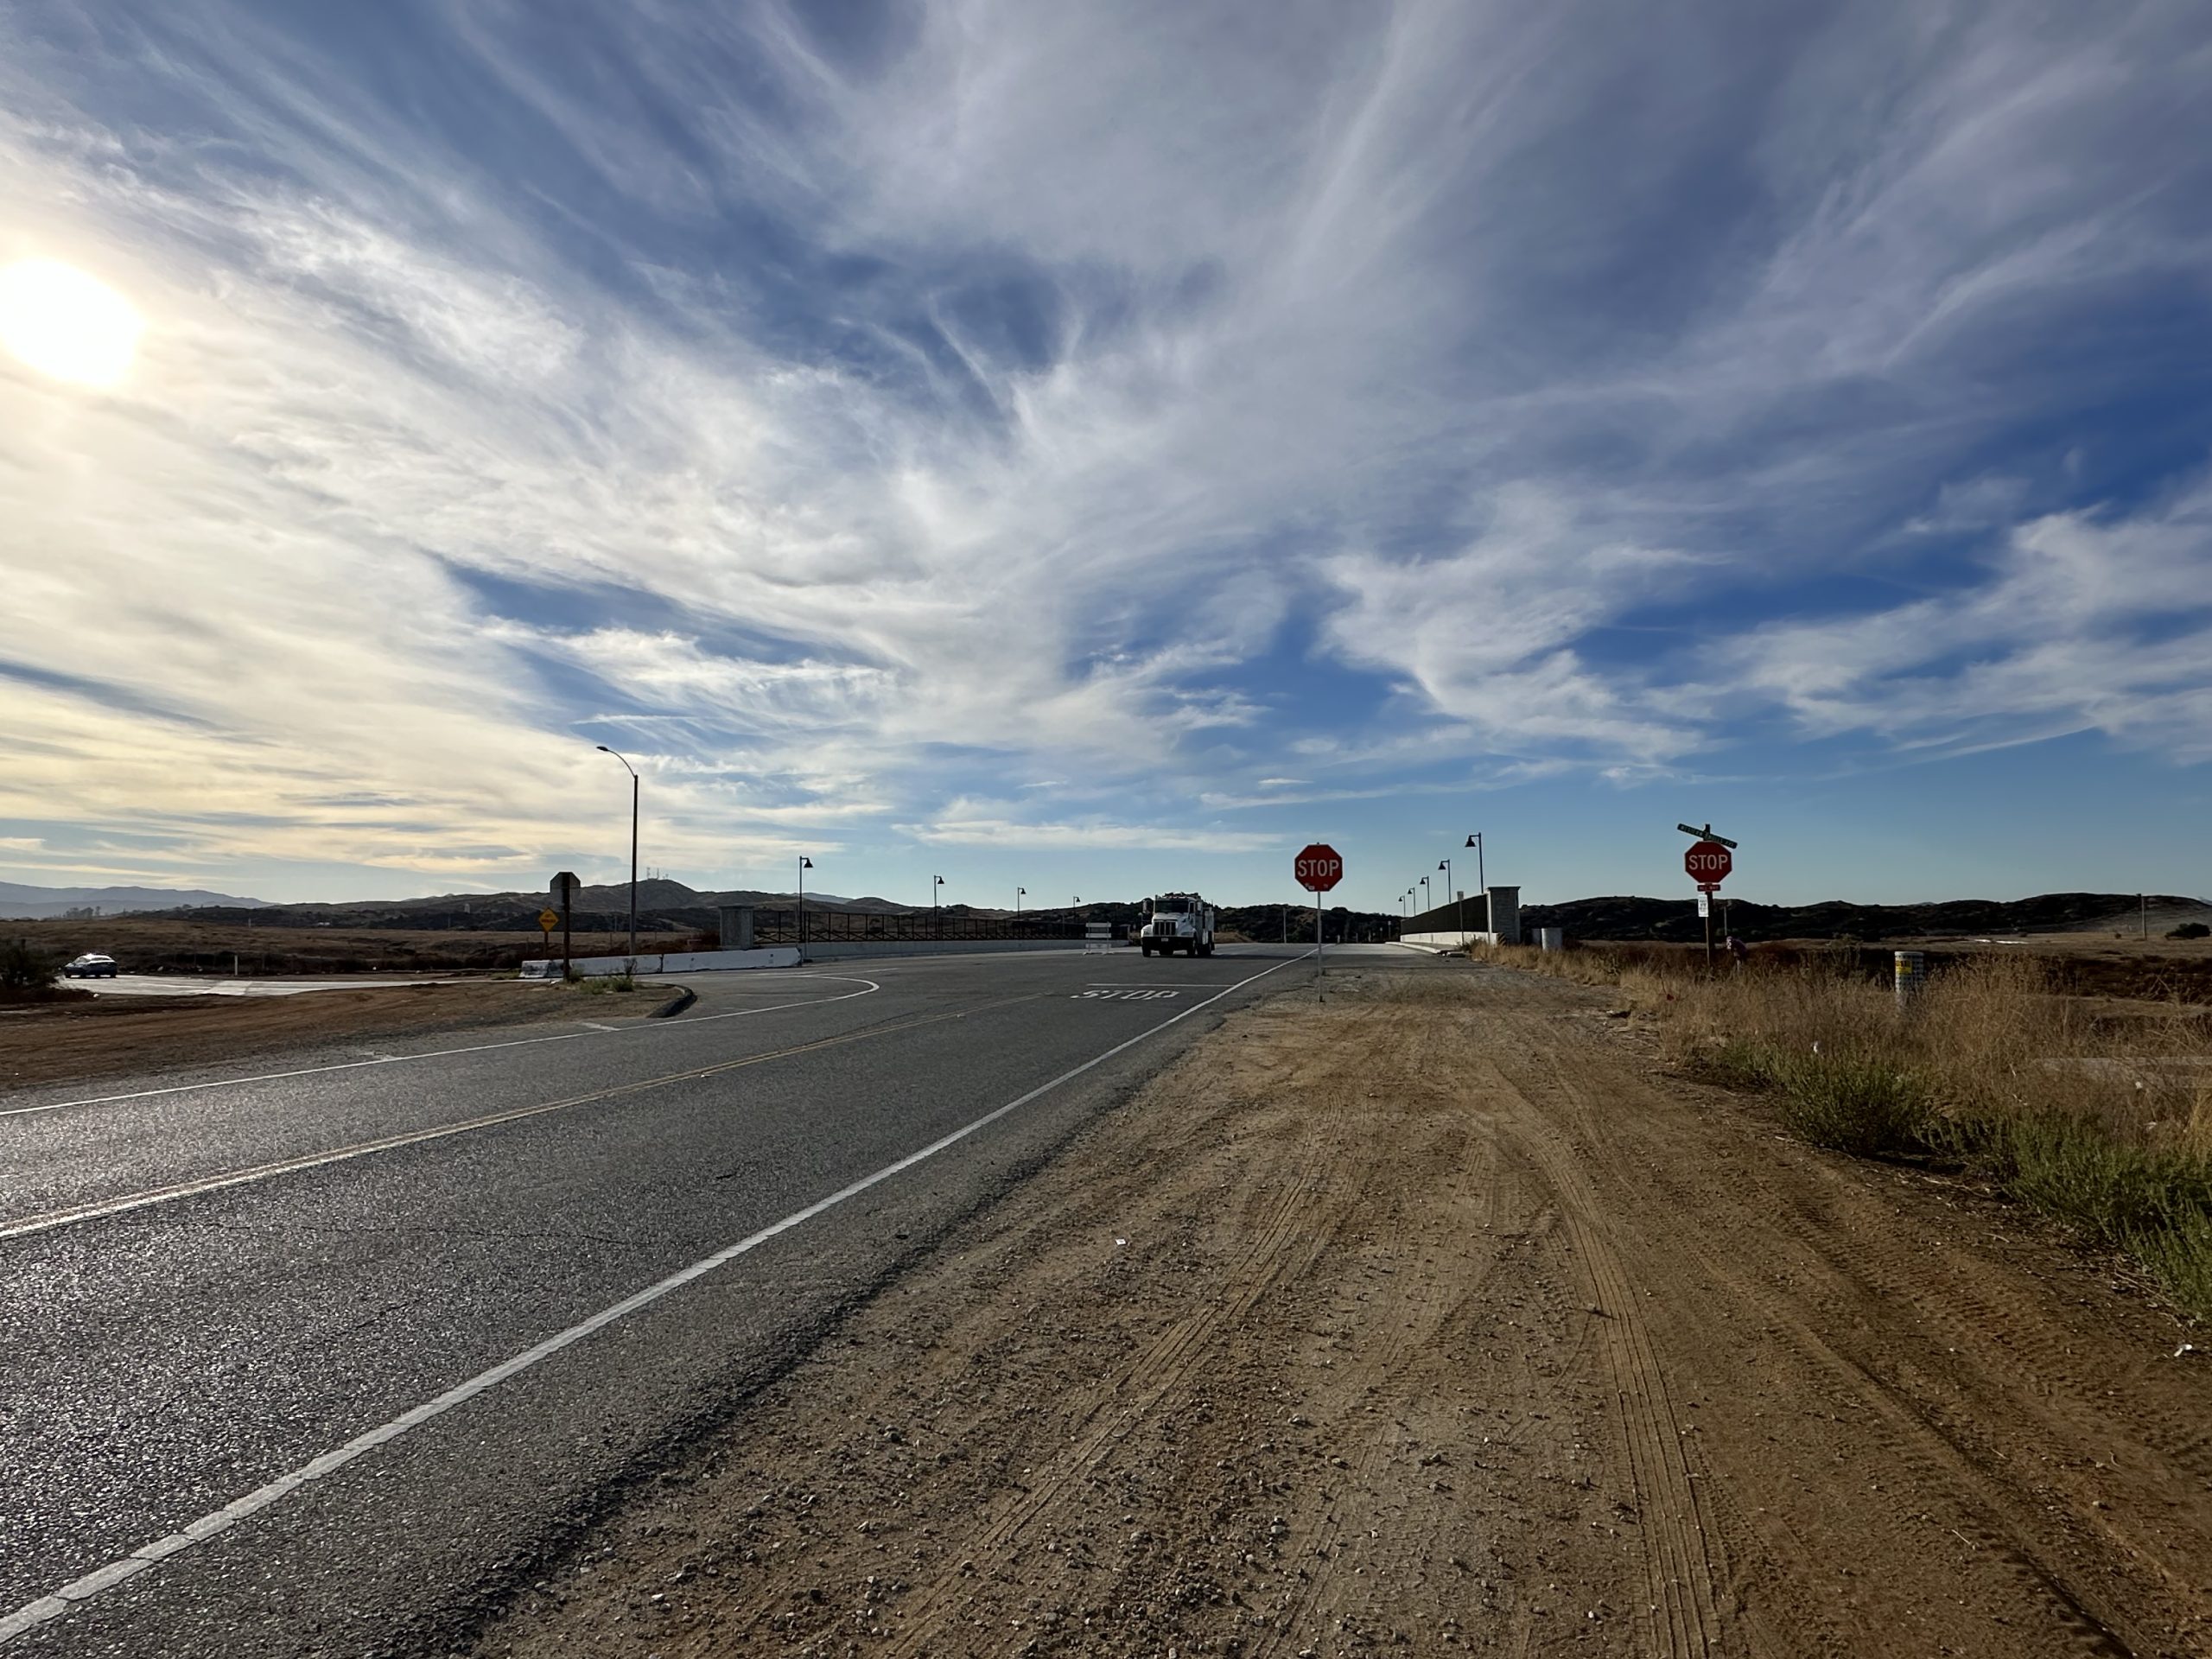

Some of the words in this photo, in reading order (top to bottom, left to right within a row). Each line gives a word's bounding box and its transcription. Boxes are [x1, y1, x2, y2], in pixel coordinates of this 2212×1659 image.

[1297, 859, 1339, 877] STOP
[1688, 855, 1728, 870] STOP
[1070, 990, 1180, 1000] STOP
